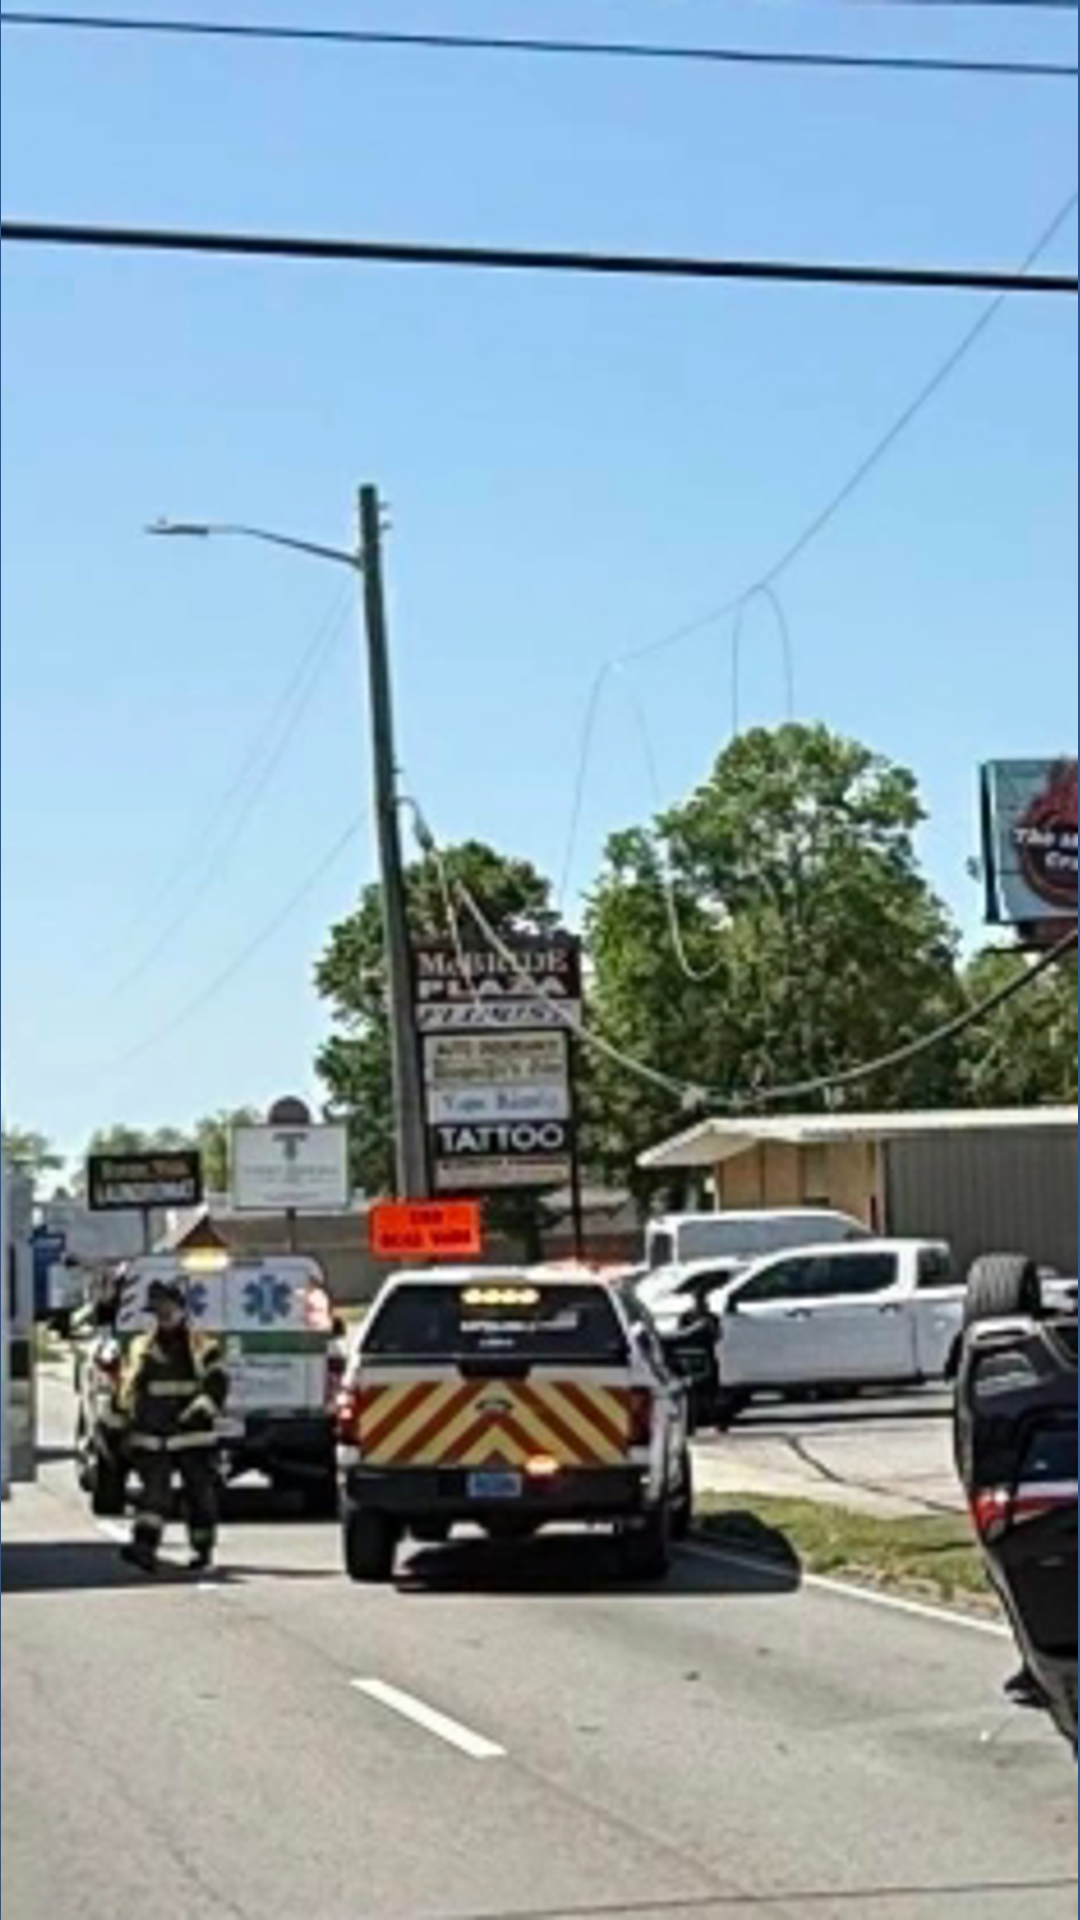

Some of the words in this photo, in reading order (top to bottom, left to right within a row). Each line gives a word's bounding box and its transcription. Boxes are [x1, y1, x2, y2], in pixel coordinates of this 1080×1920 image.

[1013, 828, 1056, 847] The
[418, 976, 568, 999] PLAZA
[438, 1123, 564, 1151] TATTOO
